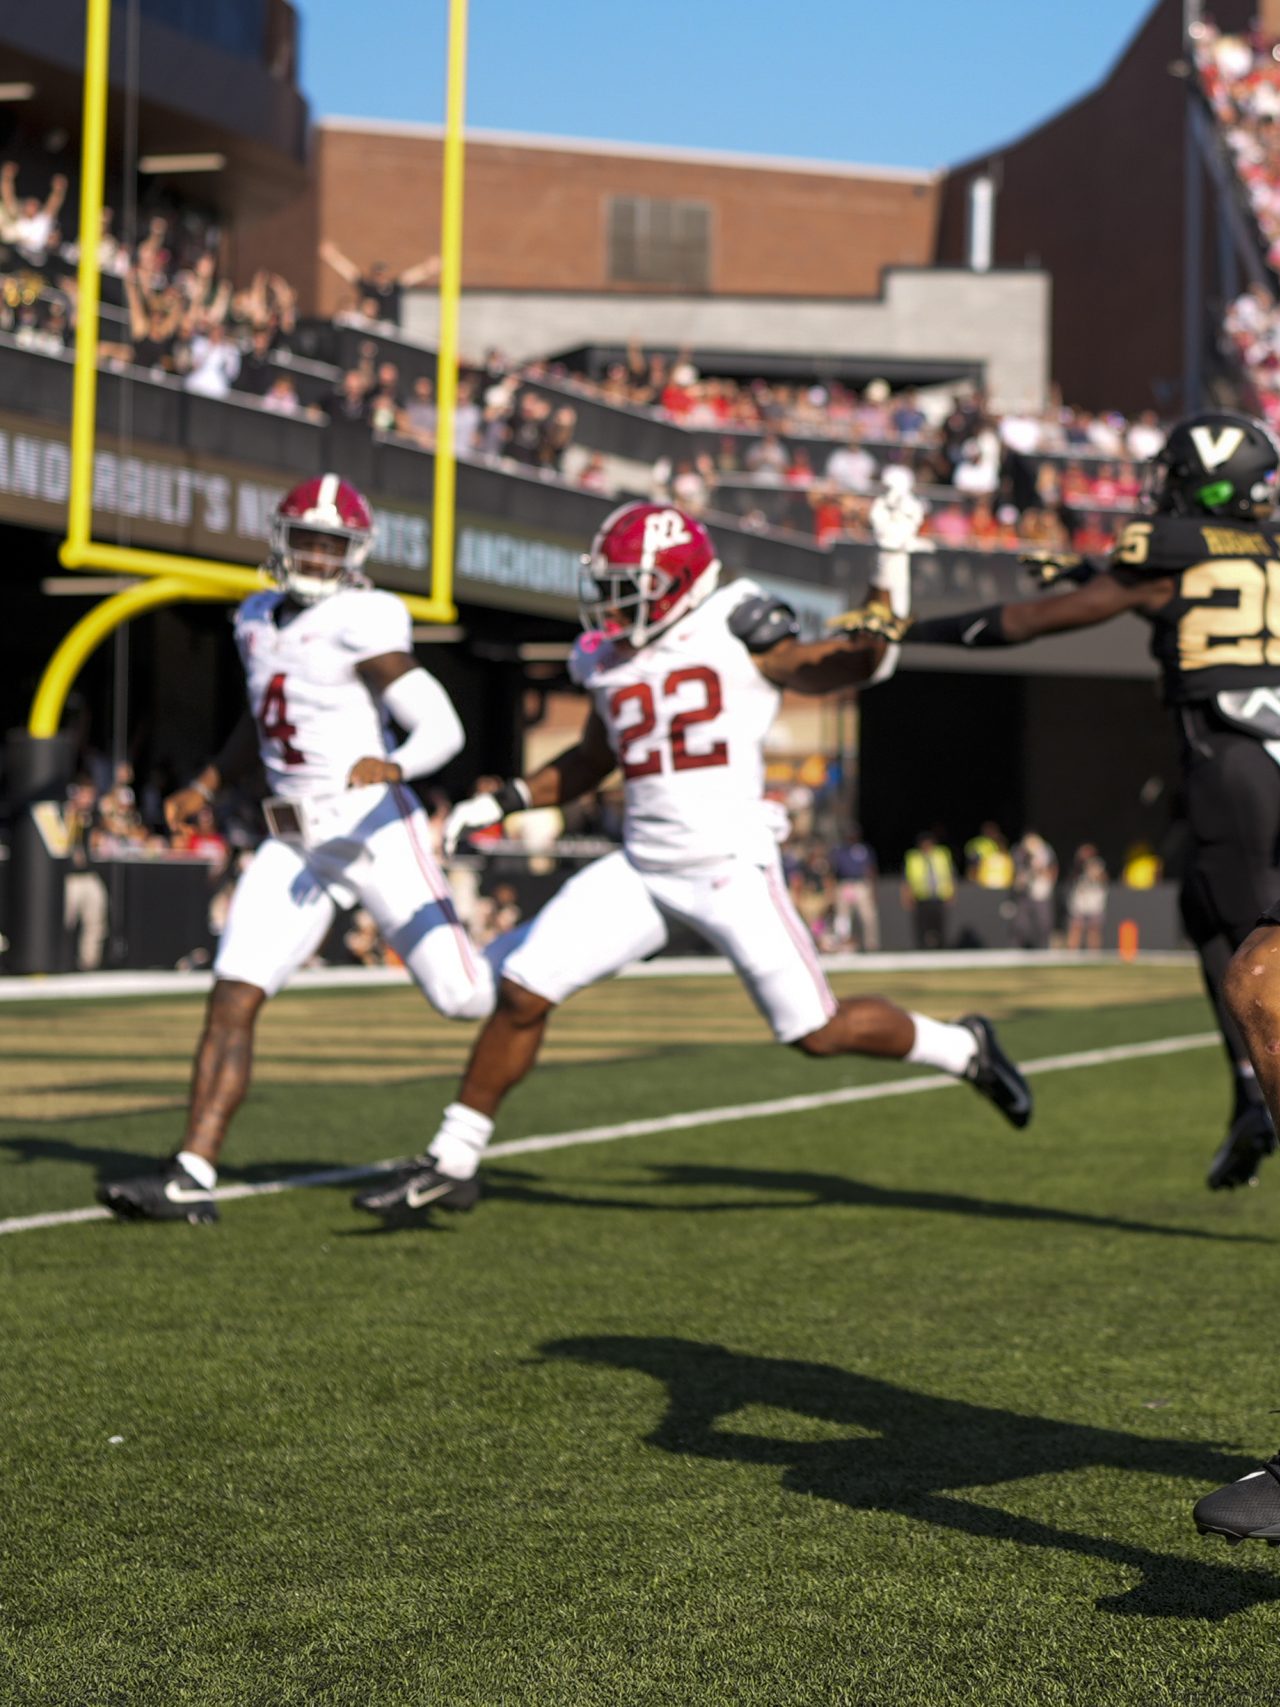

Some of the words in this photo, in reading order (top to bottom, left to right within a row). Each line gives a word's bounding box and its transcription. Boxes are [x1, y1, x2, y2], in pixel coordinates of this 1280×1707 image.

[0, 428, 231, 534] NDRBILT'S
[1189, 425, 1246, 474] V
[260, 671, 307, 765] 4
[610, 664, 730, 781] 22
